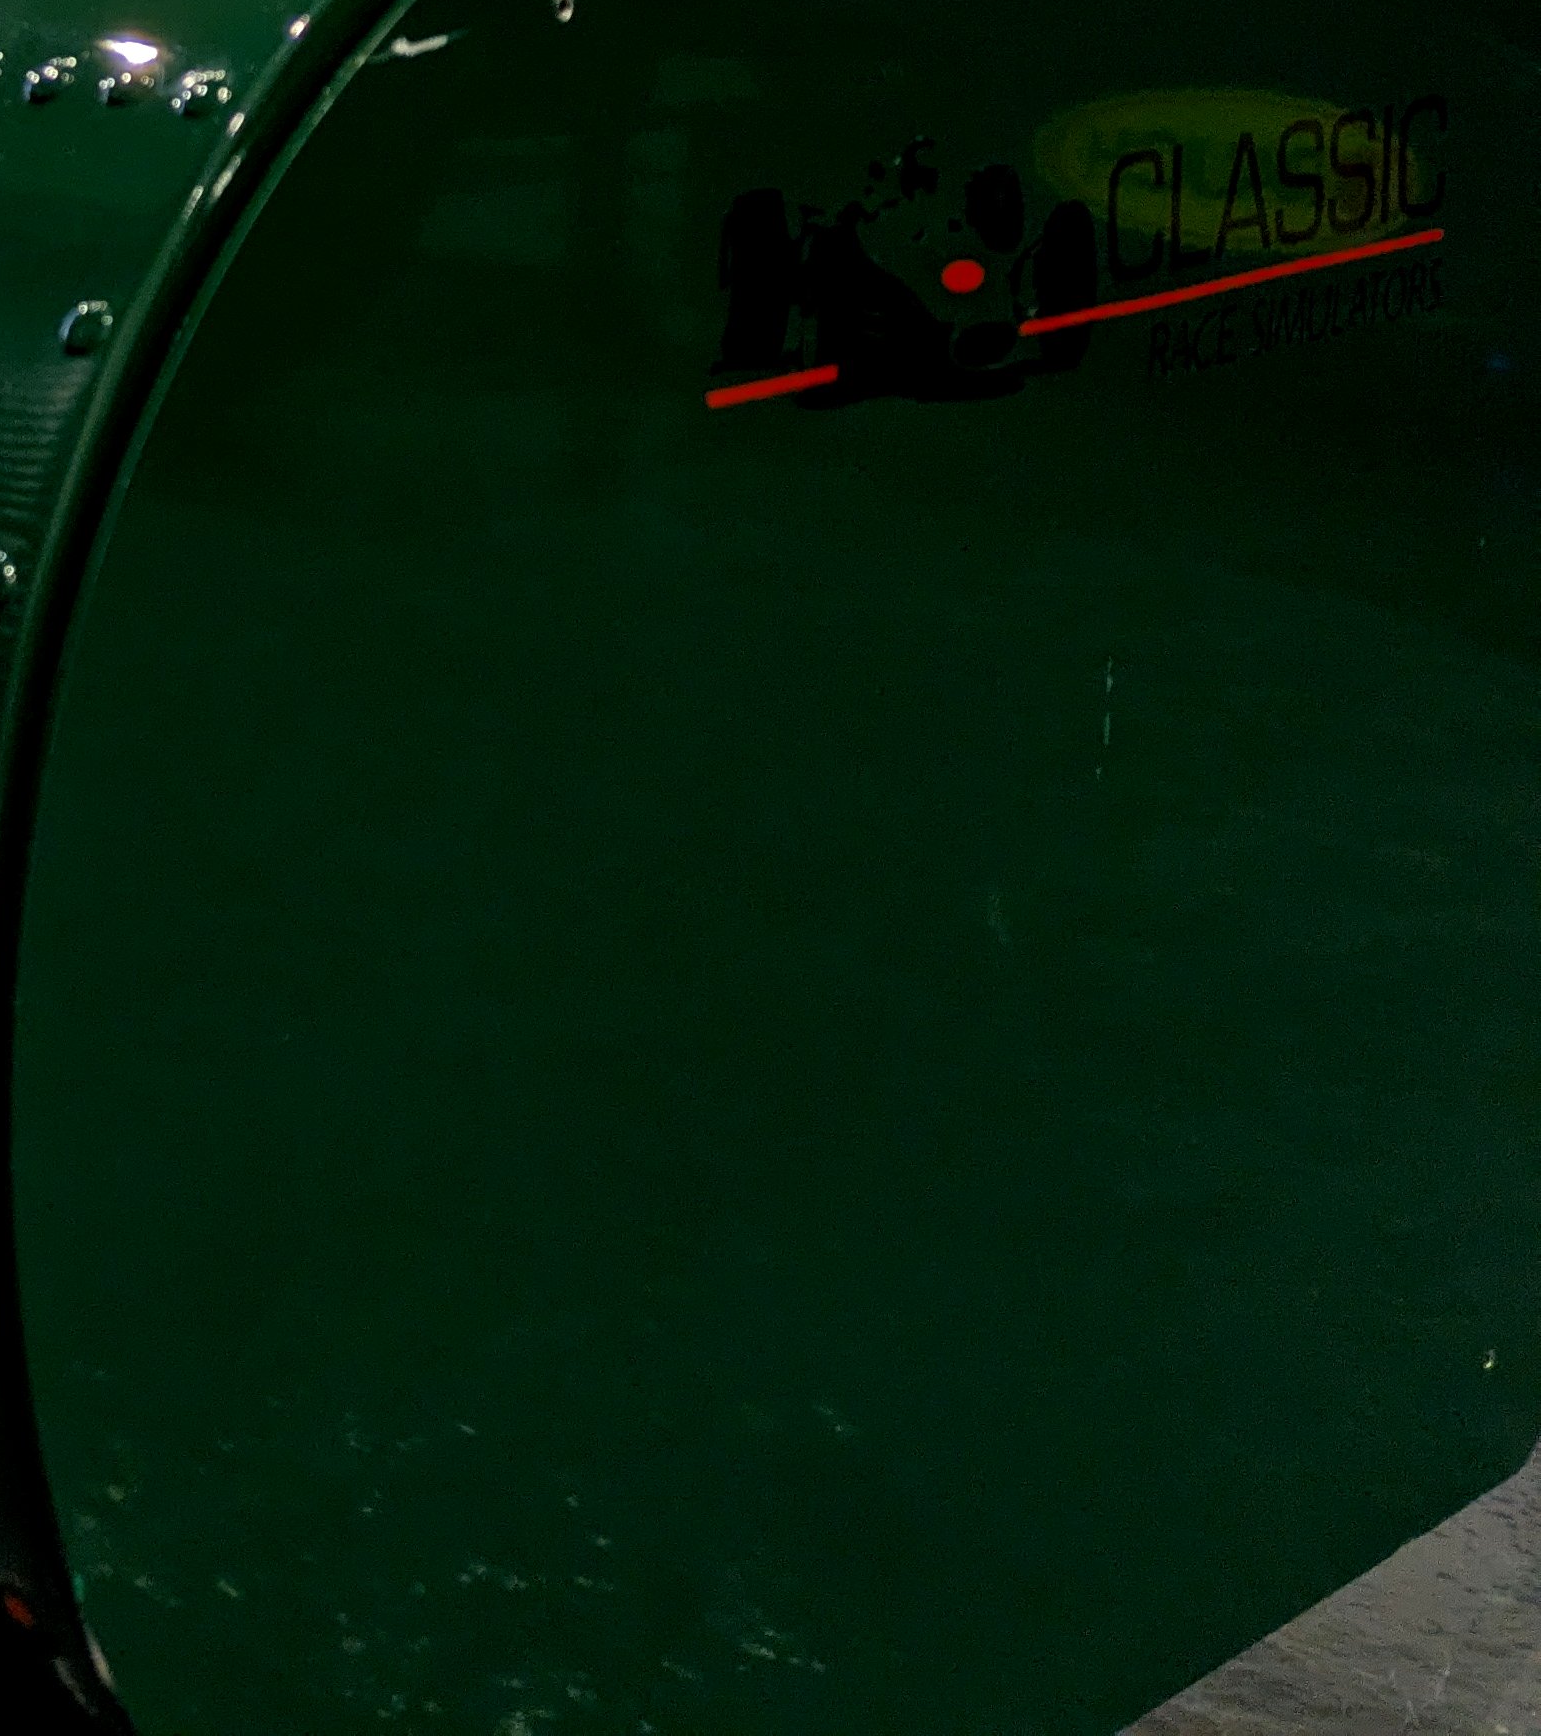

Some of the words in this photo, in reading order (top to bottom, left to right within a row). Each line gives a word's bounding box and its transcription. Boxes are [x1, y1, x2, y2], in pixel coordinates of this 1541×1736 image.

[1106, 95, 1449, 283] CLASSIC
[1147, 305, 1237, 378] RACE
[1248, 257, 1445, 357] SIMULATORS
